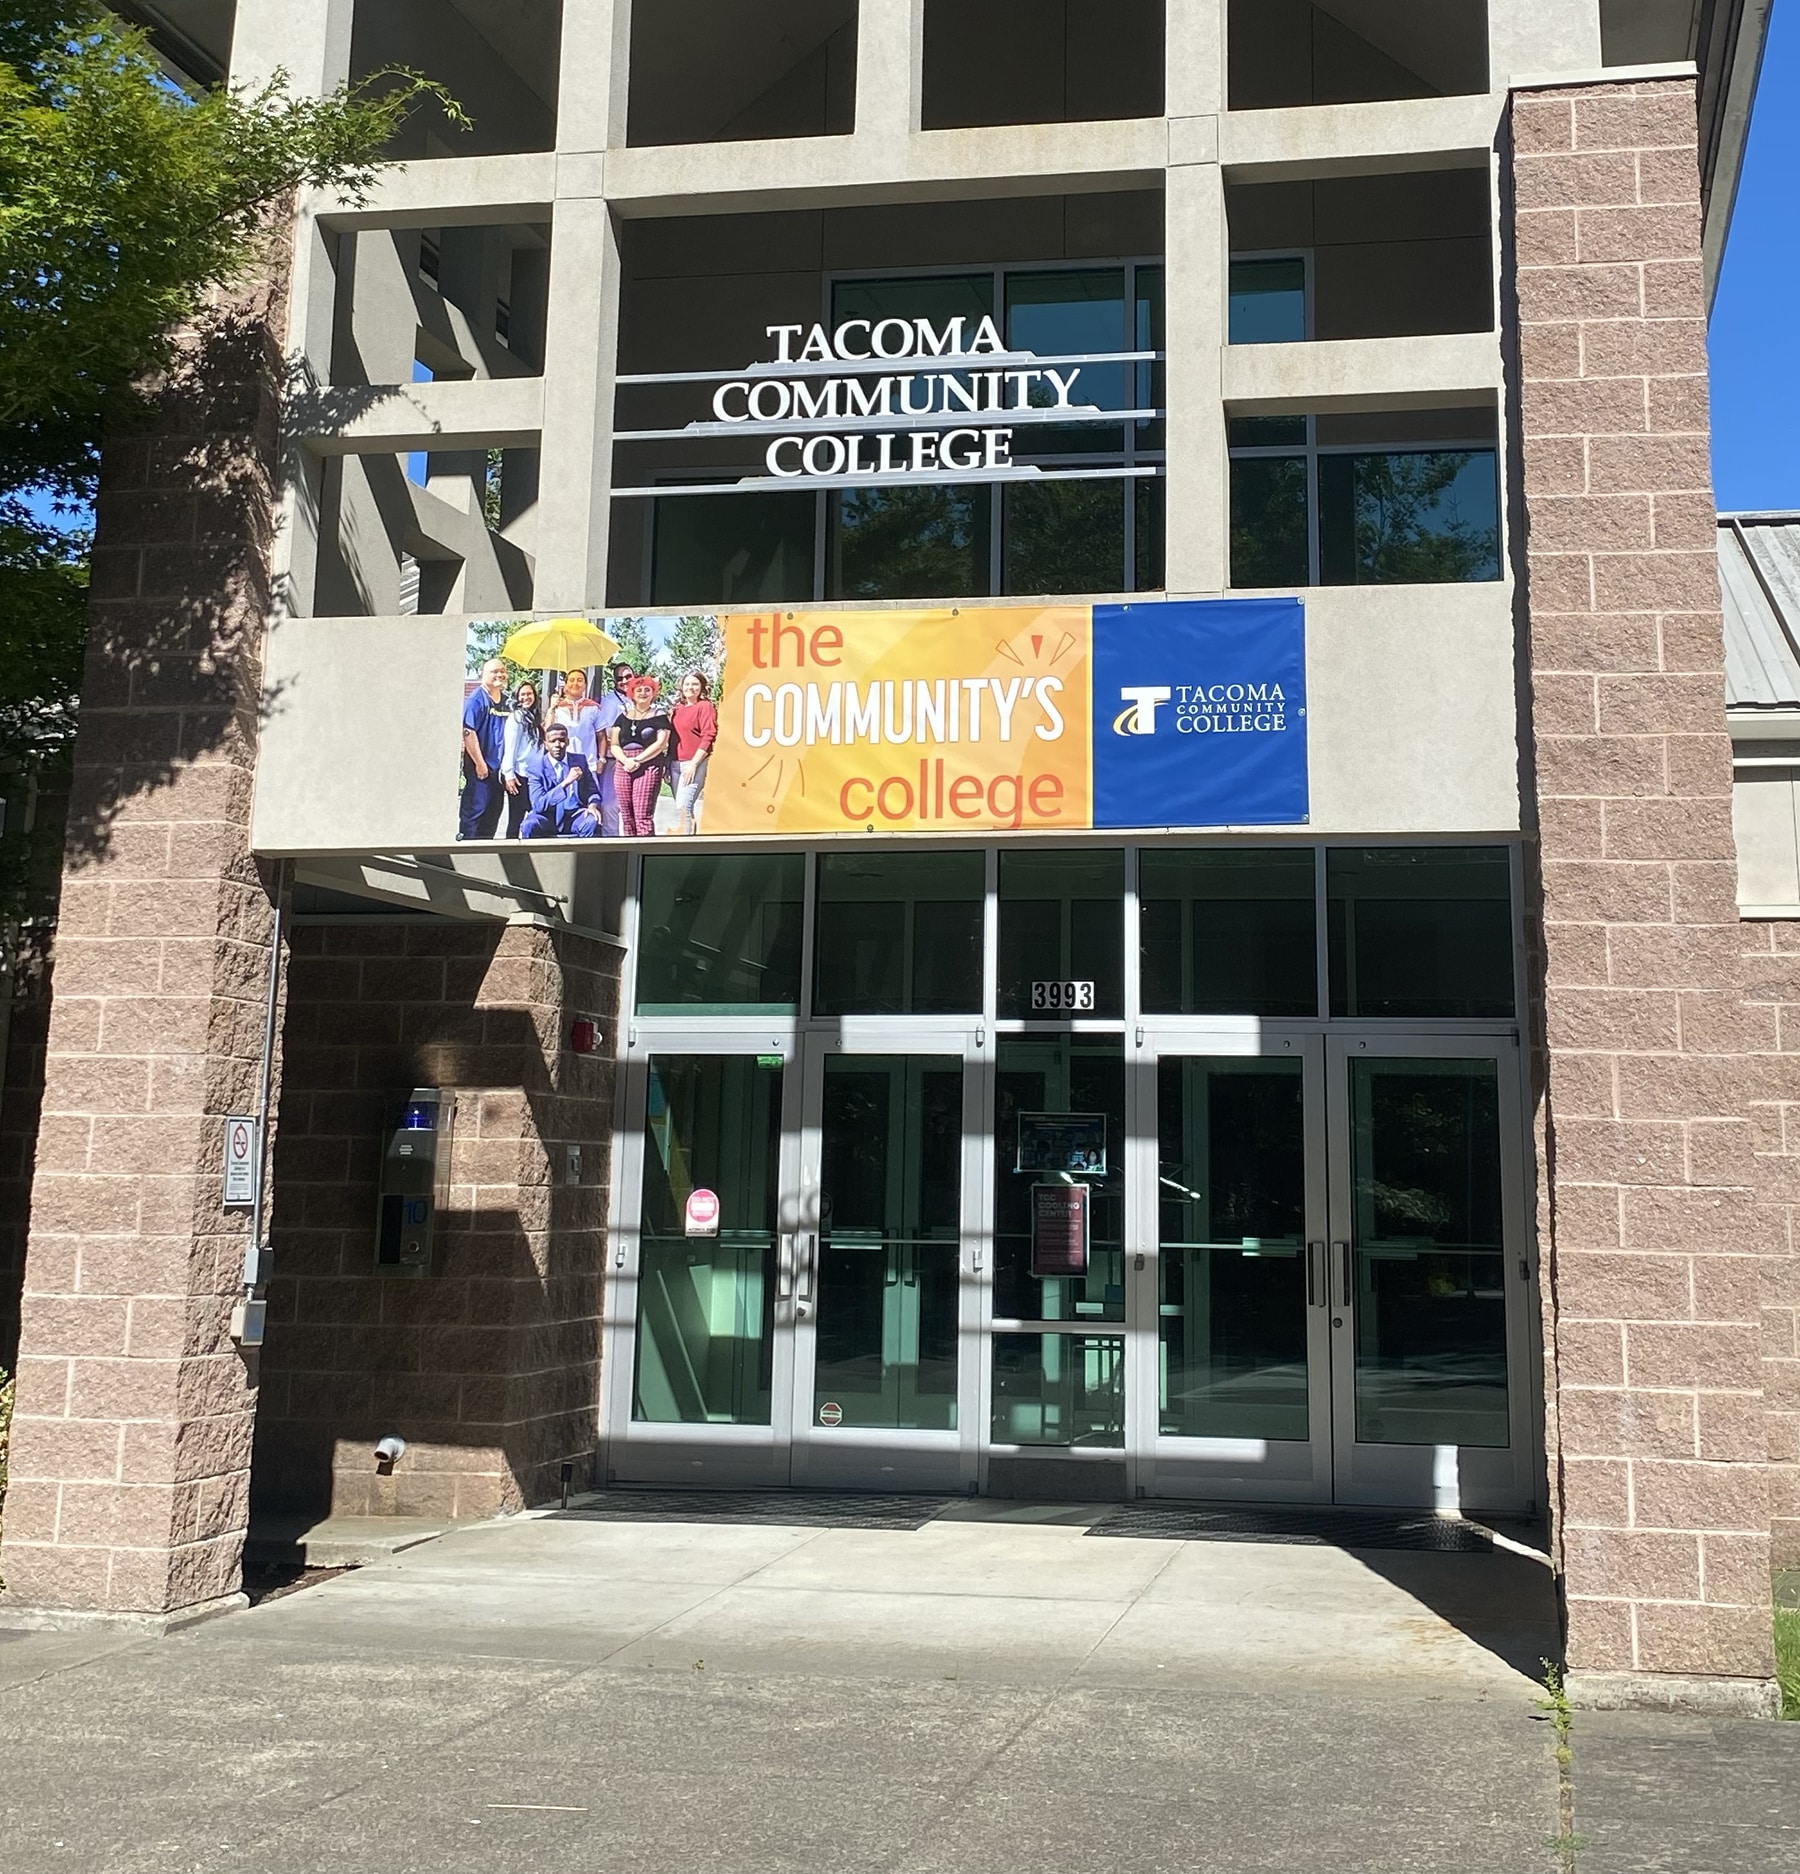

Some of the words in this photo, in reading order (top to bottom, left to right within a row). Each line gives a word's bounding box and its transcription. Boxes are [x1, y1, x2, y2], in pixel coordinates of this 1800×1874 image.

[766, 315, 1007, 364] TACOMA
[712, 367, 1081, 422] COMMUNITY
[765, 428, 1013, 477] COLLEGE
[747, 613, 843, 668] the
[743, 675, 1064, 748] COMMUNITY'S
[1176, 683, 1286, 703] TACOMA
[1176, 703, 1286, 714] COMMUNITY
[1176, 714, 1286, 733] COLLEGE
[840, 758, 1064, 830] college
[1034, 983, 1091, 1008] 3993
